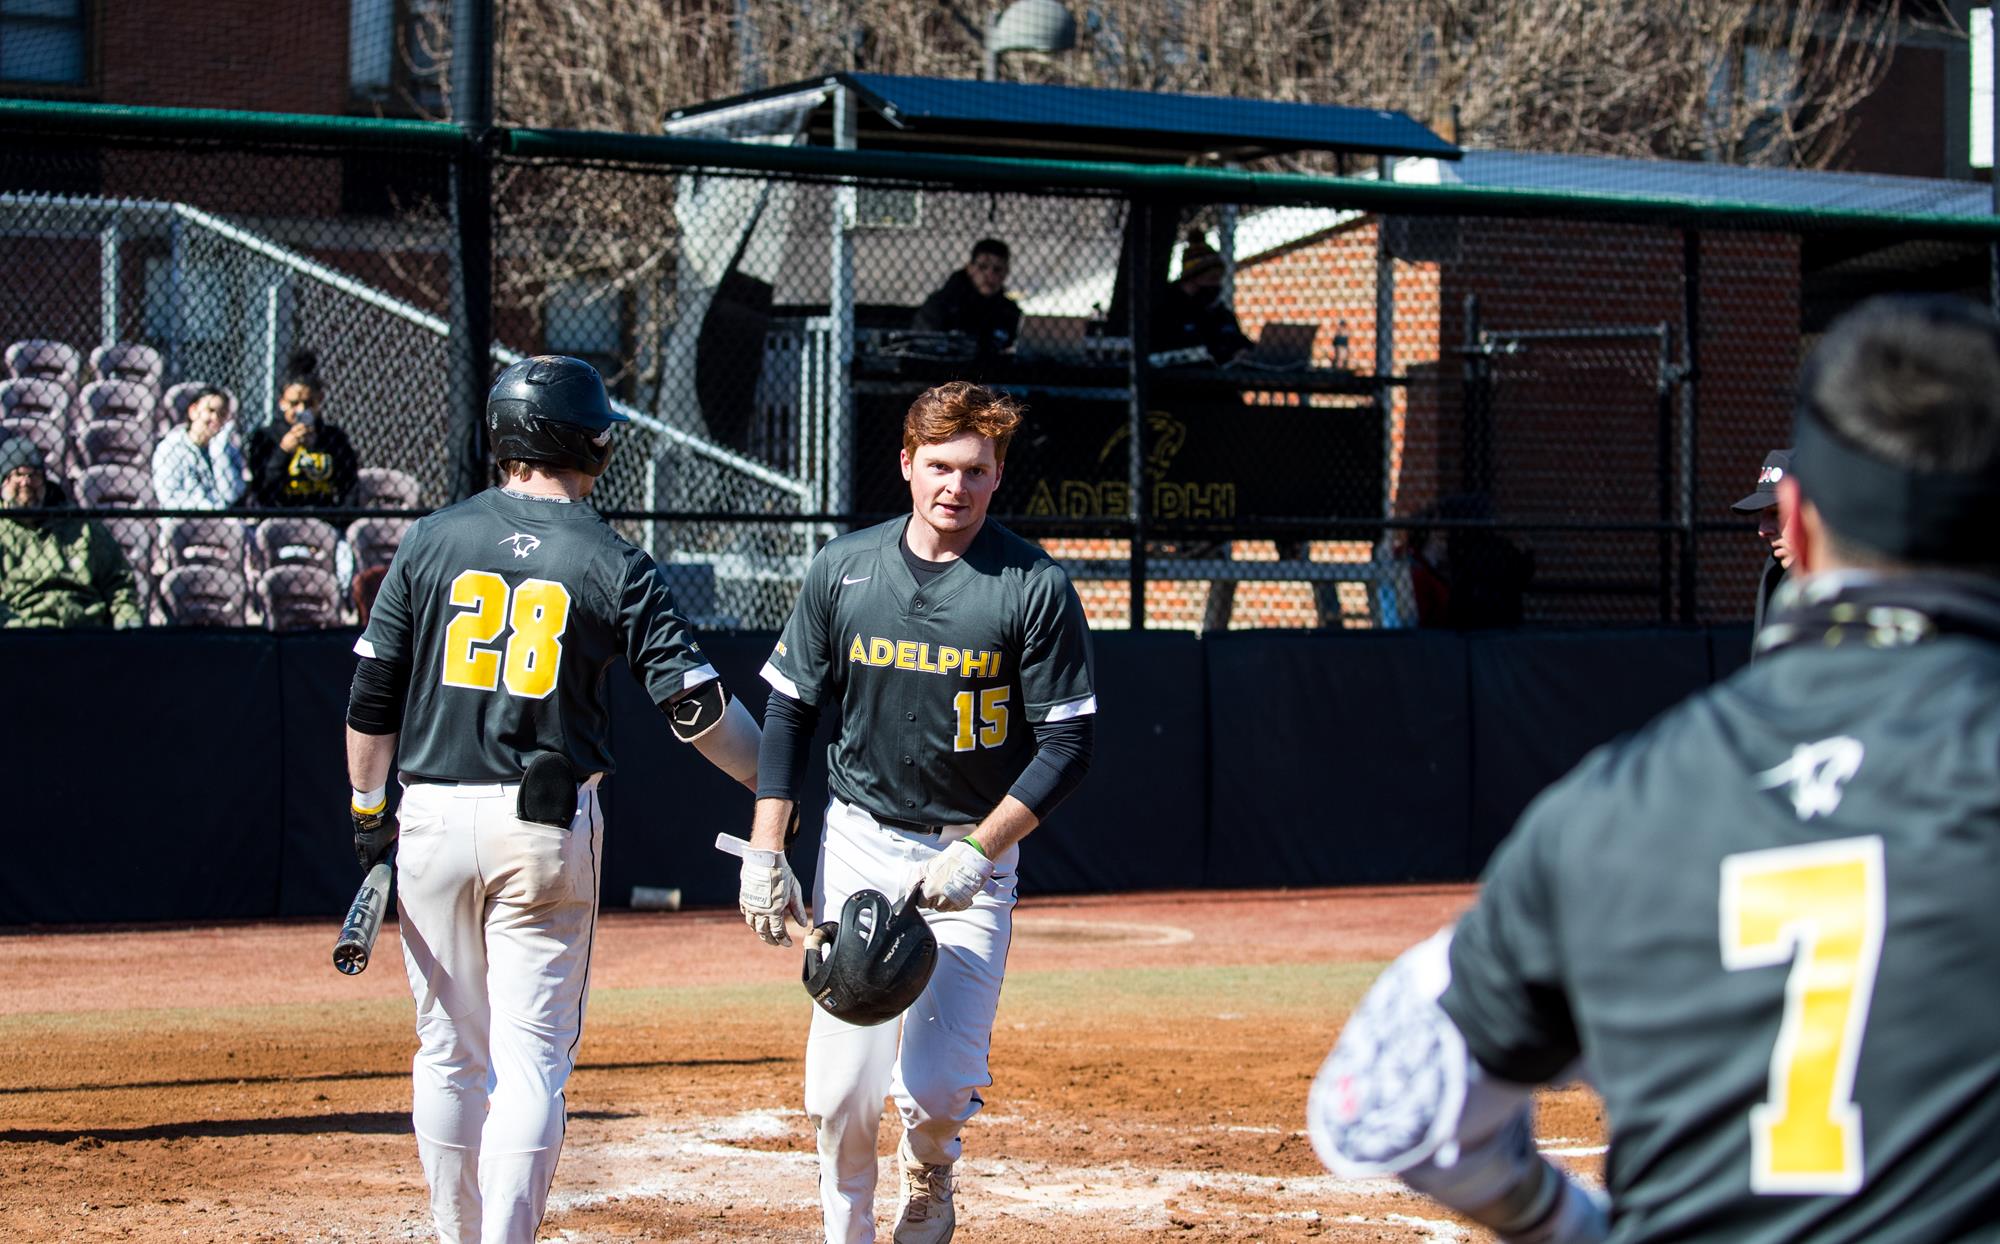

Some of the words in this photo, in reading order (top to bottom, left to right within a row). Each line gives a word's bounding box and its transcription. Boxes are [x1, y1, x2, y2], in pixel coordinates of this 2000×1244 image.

[1025, 479, 1237, 531] ADEPHI
[442, 569, 571, 699] 28
[849, 632, 1002, 678] ADELPHI
[953, 685, 1010, 752] 15
[1718, 834, 1887, 1195] 7
